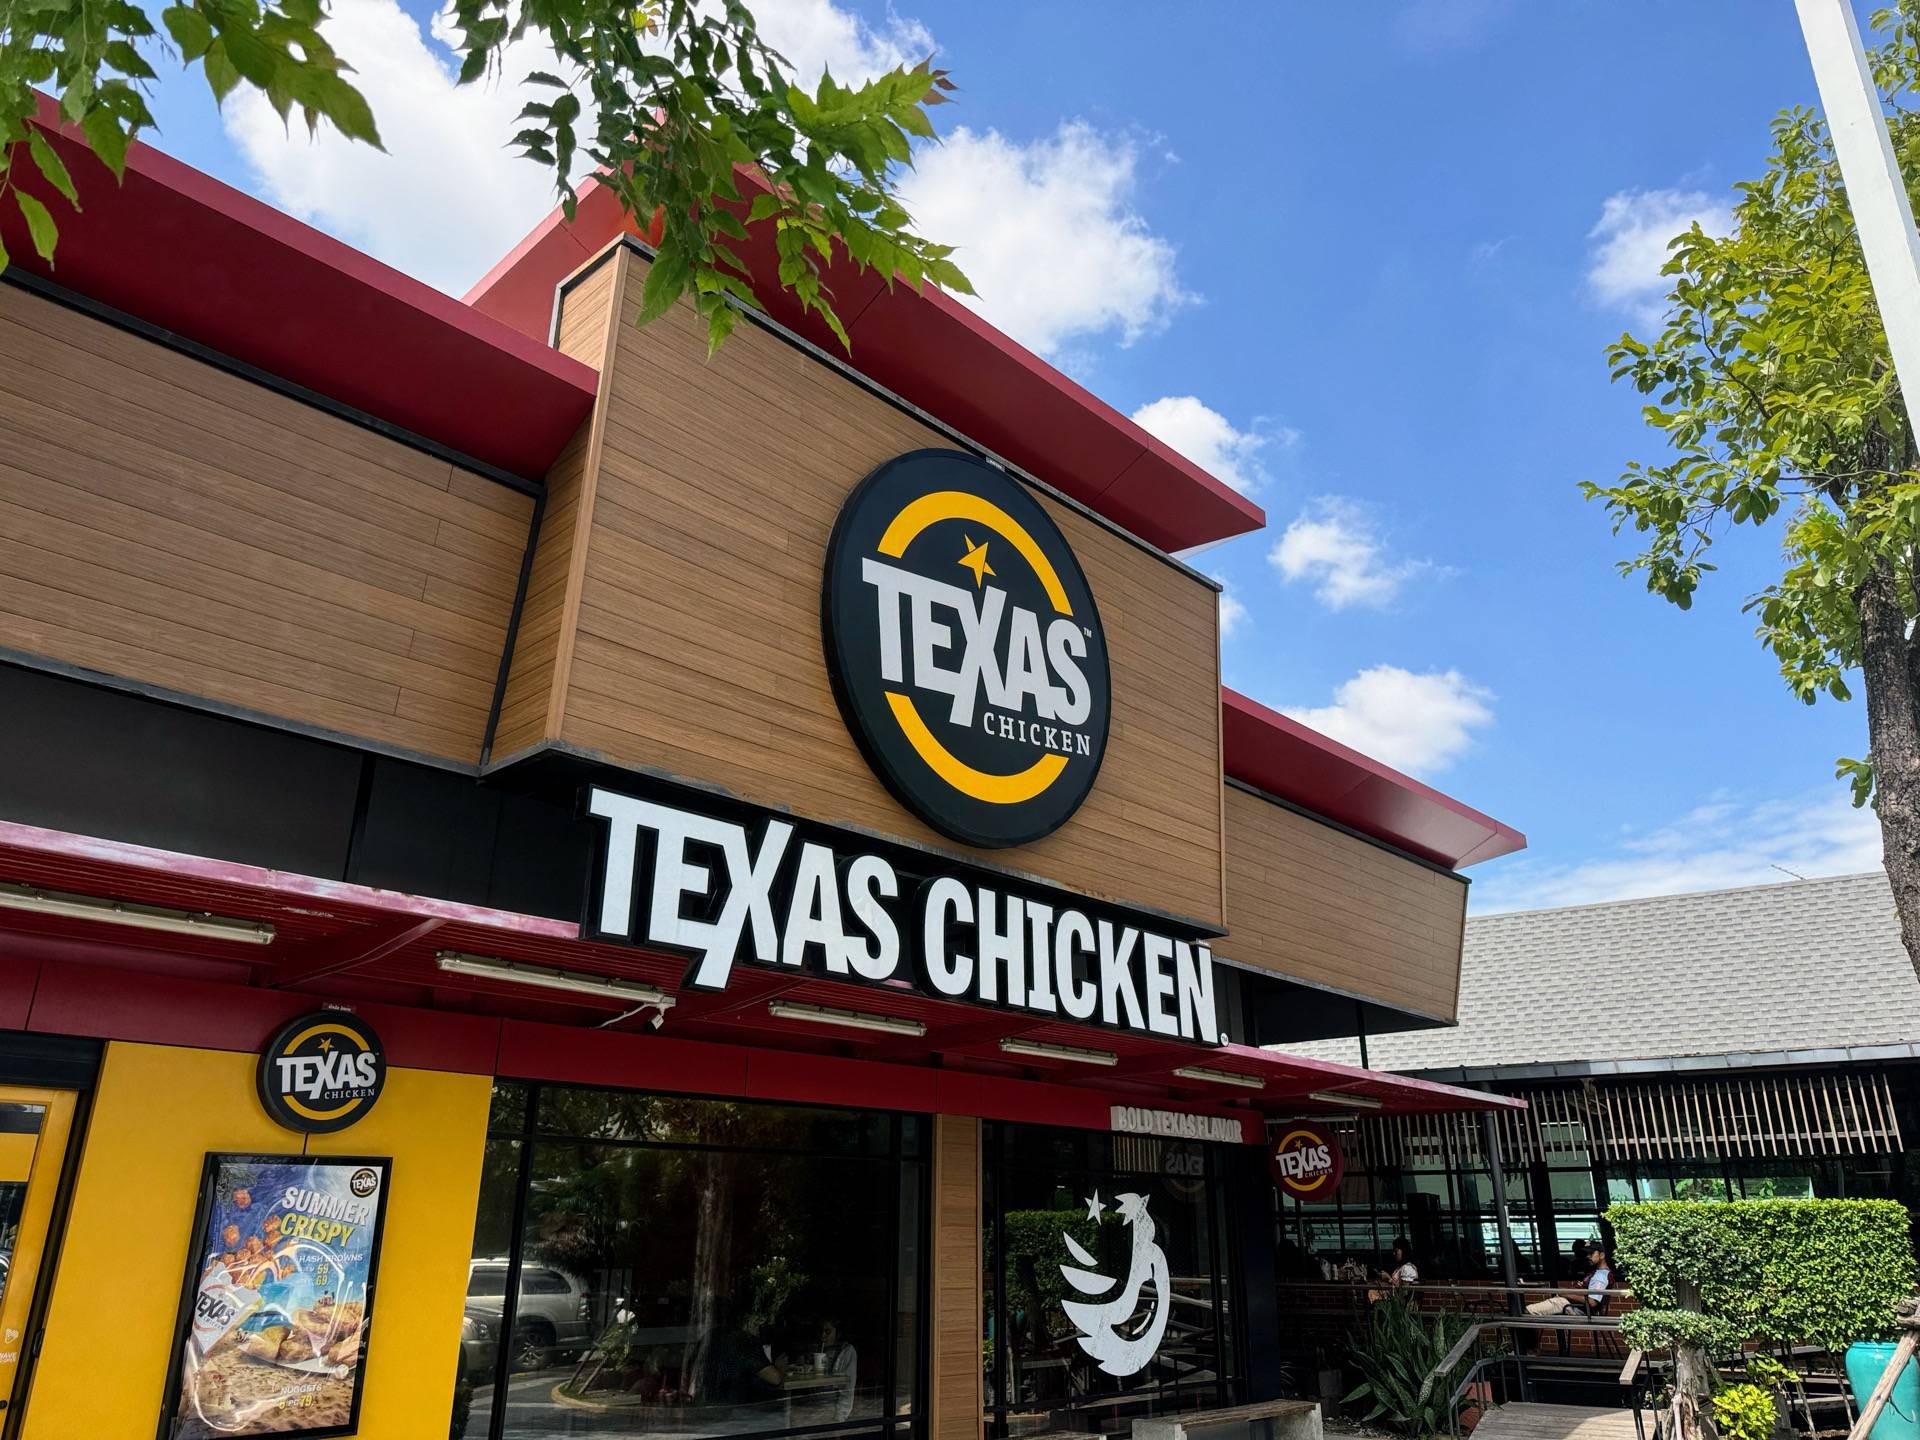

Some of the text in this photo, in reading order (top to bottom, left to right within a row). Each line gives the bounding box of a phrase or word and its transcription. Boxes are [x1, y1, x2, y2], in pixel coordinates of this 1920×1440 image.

[862, 557, 1091, 727] TEXAS
[983, 711, 1091, 757] CHICKEN
[589, 787, 1218, 1044] TEXAS CHICKEN
[275, 1051, 377, 1100] TEXAS
[324, 1088, 375, 1100] CHICKEN
[1113, 1106, 1243, 1143] BOLD TEXAS FLAVOR
[1275, 1145, 1332, 1179] TEXAS
[1304, 1168, 1333, 1178] CHICKEN
[352, 1177, 377, 1191] TEXAS
[282, 1186, 369, 1225] SUMMER
[280, 1212, 354, 1247] CRISPY
[196, 1291, 236, 1326] TEXAS
